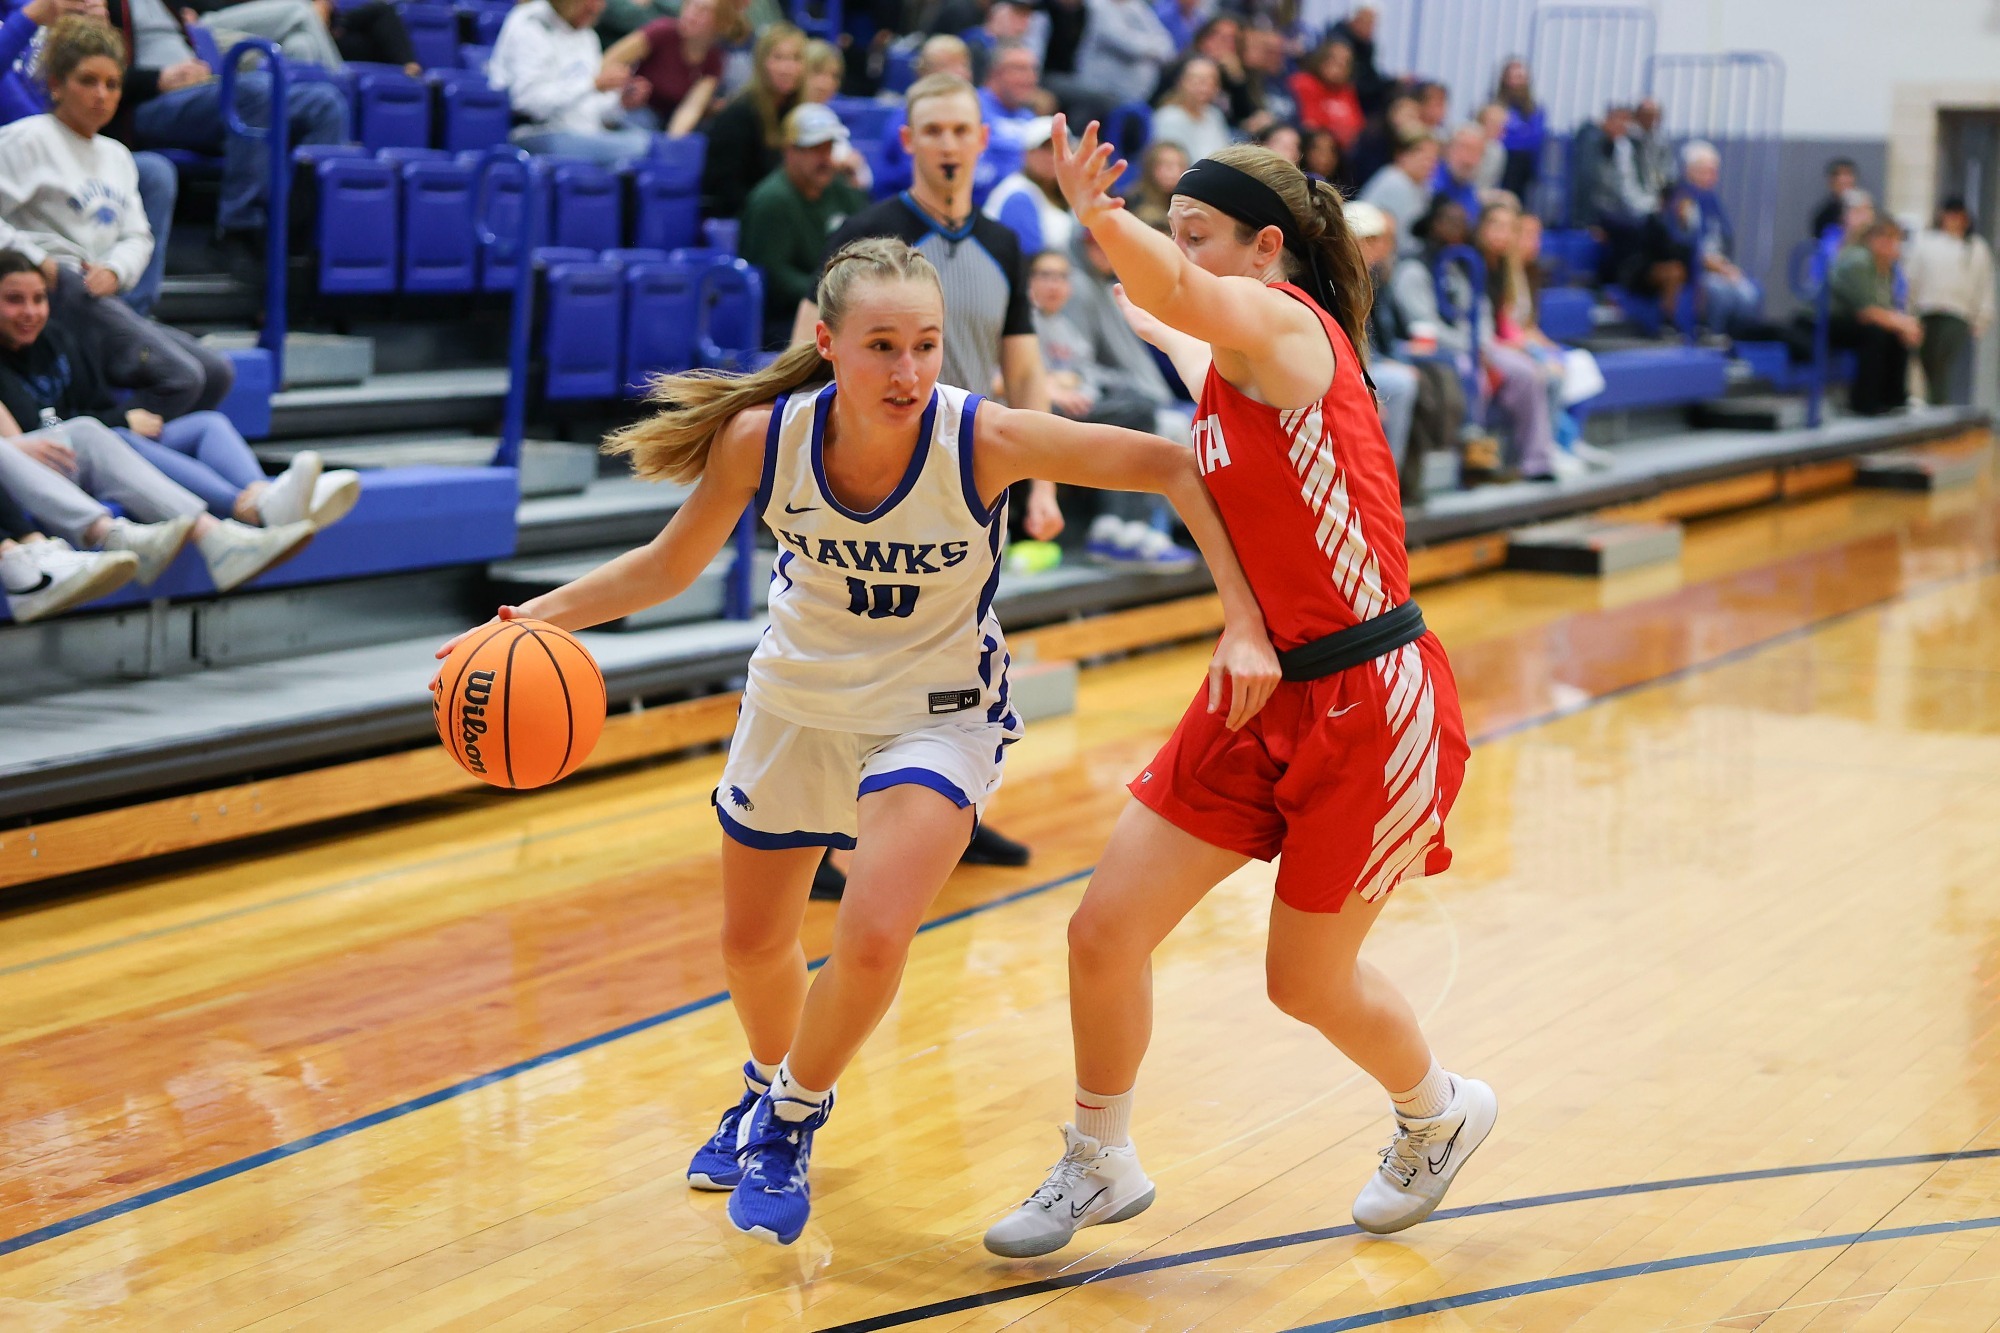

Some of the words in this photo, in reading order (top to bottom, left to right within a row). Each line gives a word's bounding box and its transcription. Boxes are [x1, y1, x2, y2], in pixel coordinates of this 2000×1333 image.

[779, 529, 969, 574] HAWKS
[846, 576, 920, 619] 10
[462, 669, 497, 774] Wilson
[964, 696, 973, 705] M
